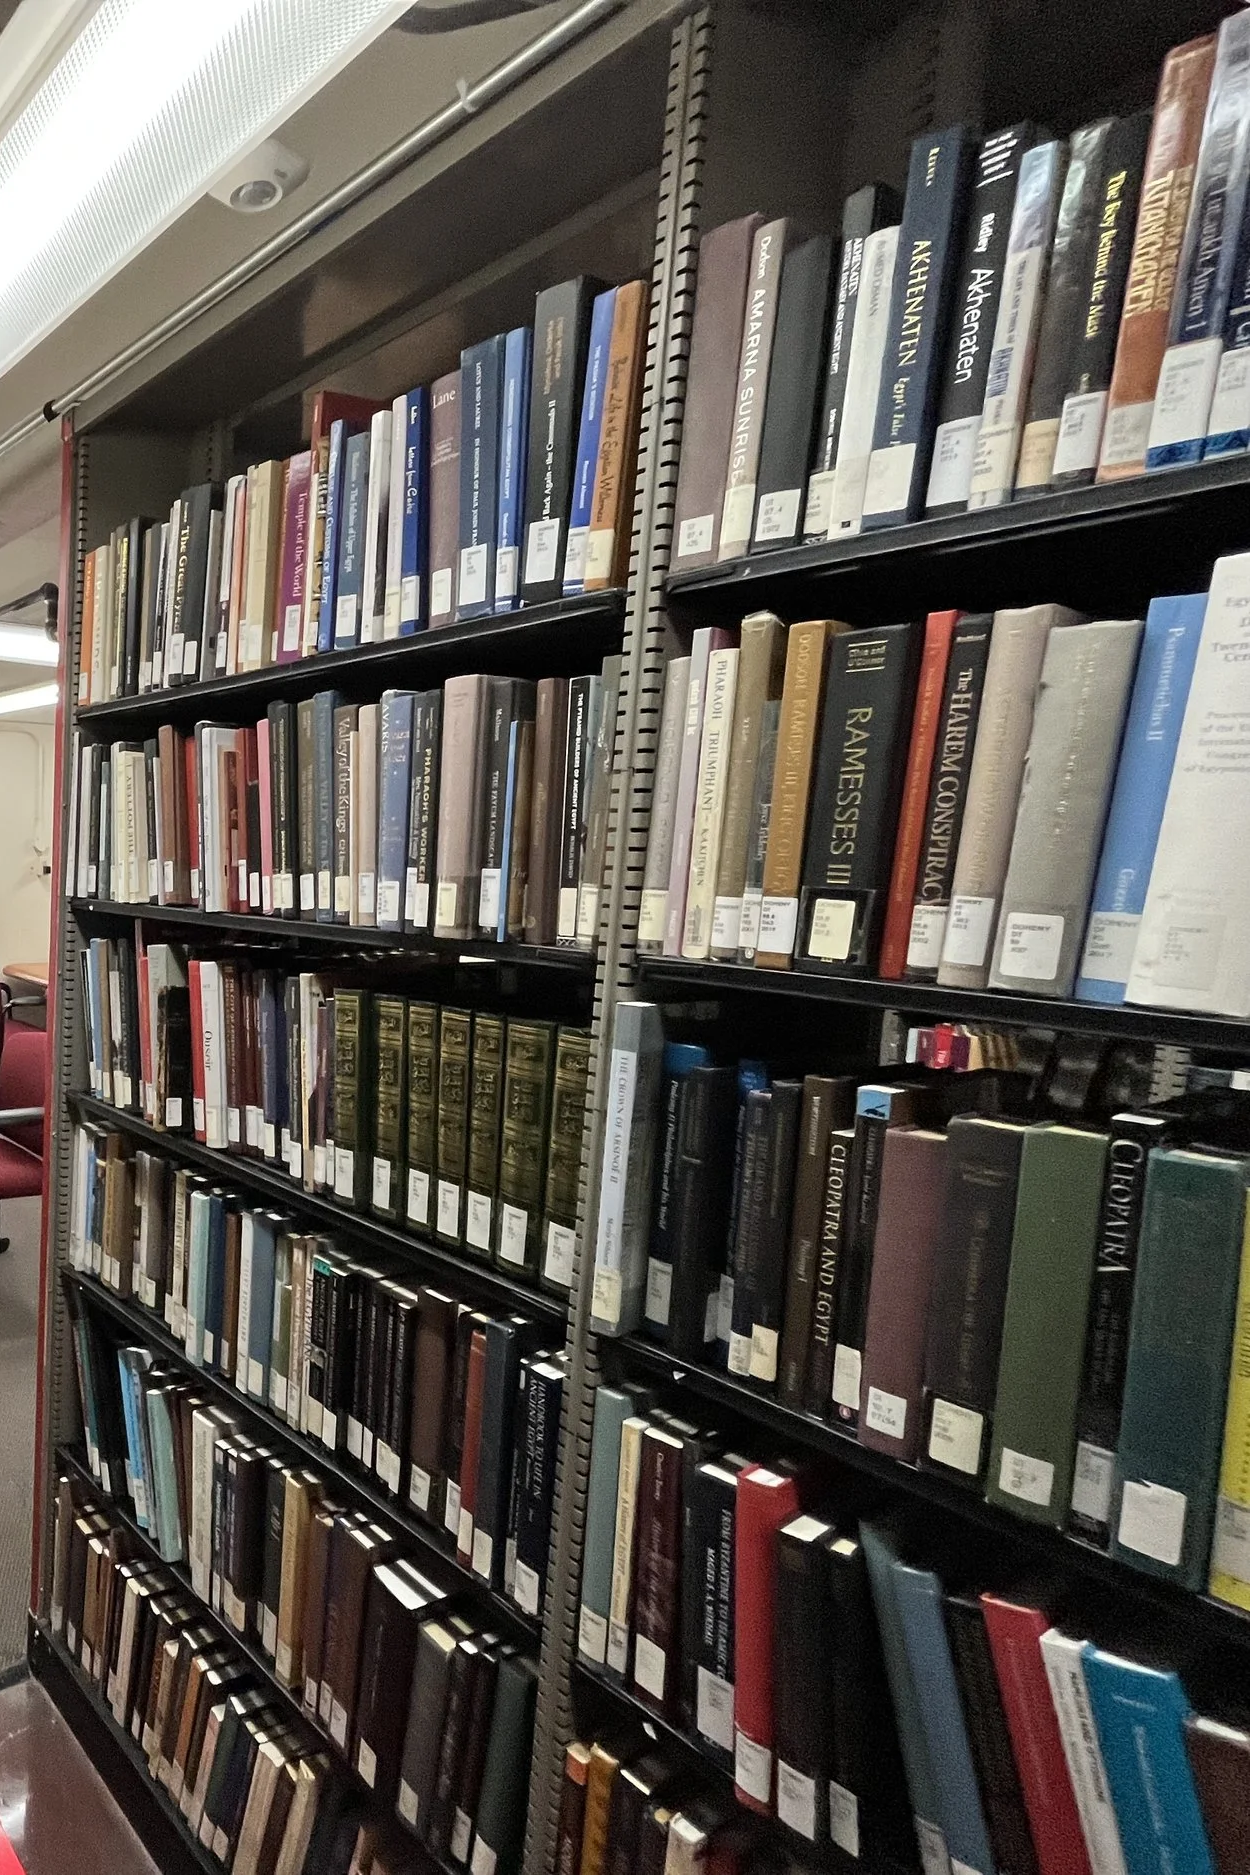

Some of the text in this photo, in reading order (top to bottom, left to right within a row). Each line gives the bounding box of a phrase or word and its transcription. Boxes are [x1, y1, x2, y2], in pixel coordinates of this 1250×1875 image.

[974, 213, 996, 253] Ridley
[1123, 168, 1174, 319] TUTANKHAMEN
[741, 288, 767, 380] AMARNA
[898, 239, 933, 367] AKHENATEN
[954, 268, 995, 384] Akhenaten
[432, 390, 457, 410] Lane
[177, 525, 190, 594] The Great
[292, 491, 306, 597] Temple of the World
[711, 659, 729, 720] PHARAOH
[955, 668, 973, 692] The
[337, 717, 351, 757] Valley
[381, 703, 390, 753] AVARIS
[938, 691, 972, 772] HAREM
[338, 772, 349, 794] the
[701, 729, 721, 812] TRIUMPHANT
[826, 706, 875, 885] RAMESSES III
[336, 795, 349, 833] Kings
[419, 747, 433, 883] PHARAOH'S WORKER
[916, 775, 958, 904] CONSPIRACY
[615, 1077, 627, 1114] CROWN
[619, 1056, 629, 1074] THE
[614, 1116, 624, 1129] OF
[813, 1143, 847, 1347] CLEOPATRA AND EGYPT
[1097, 1139, 1143, 1272] CLEOPATRA
[526, 1376, 537, 1459] ANCIENT EGYPT
[533, 1380, 547, 1500] HANDBOOK TO LIFE IN
[717, 1509, 731, 1664] FROM BYZANTINE TO ISLAMIC
